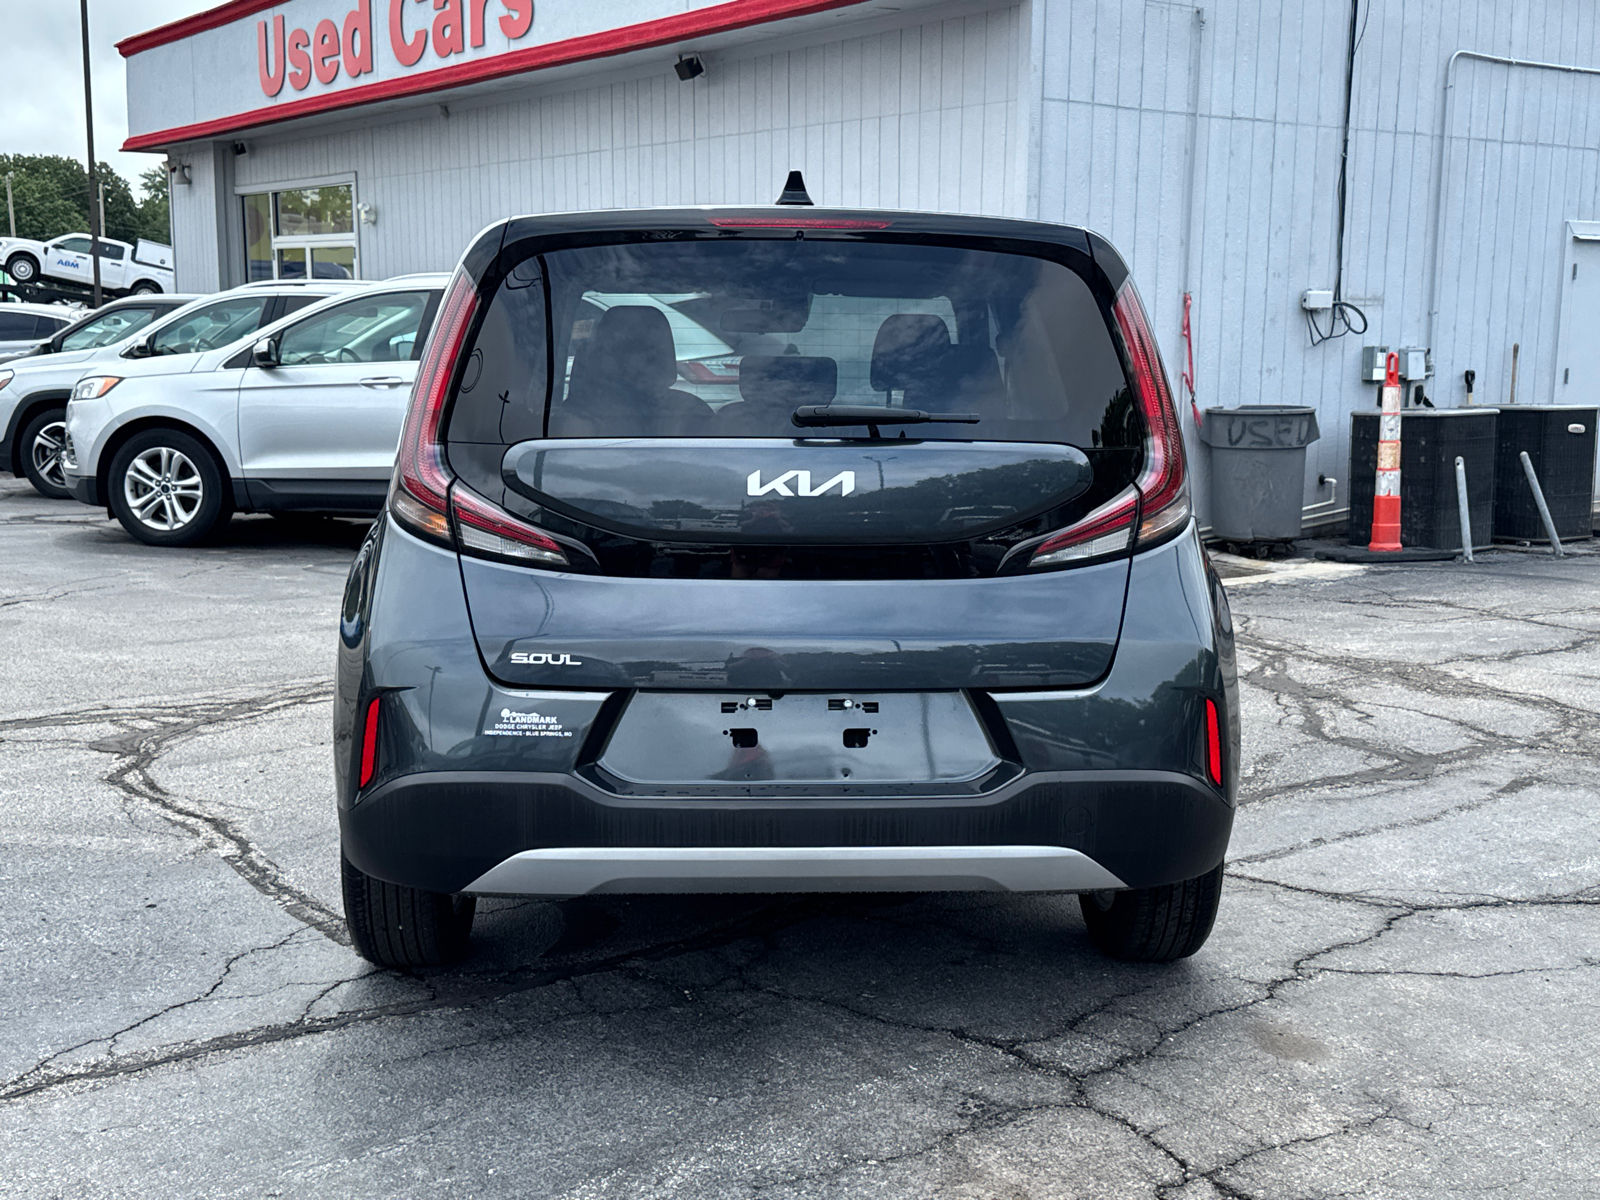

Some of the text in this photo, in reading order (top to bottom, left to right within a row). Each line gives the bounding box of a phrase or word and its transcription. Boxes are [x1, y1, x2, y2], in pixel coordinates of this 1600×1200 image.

[257, 0, 533, 97] Used Cars
[56, 259, 80, 269] ABM
[1227, 417, 1309, 446] USED
[511, 653, 582, 665] SOUL
[510, 716, 557, 724] LANDMARK
